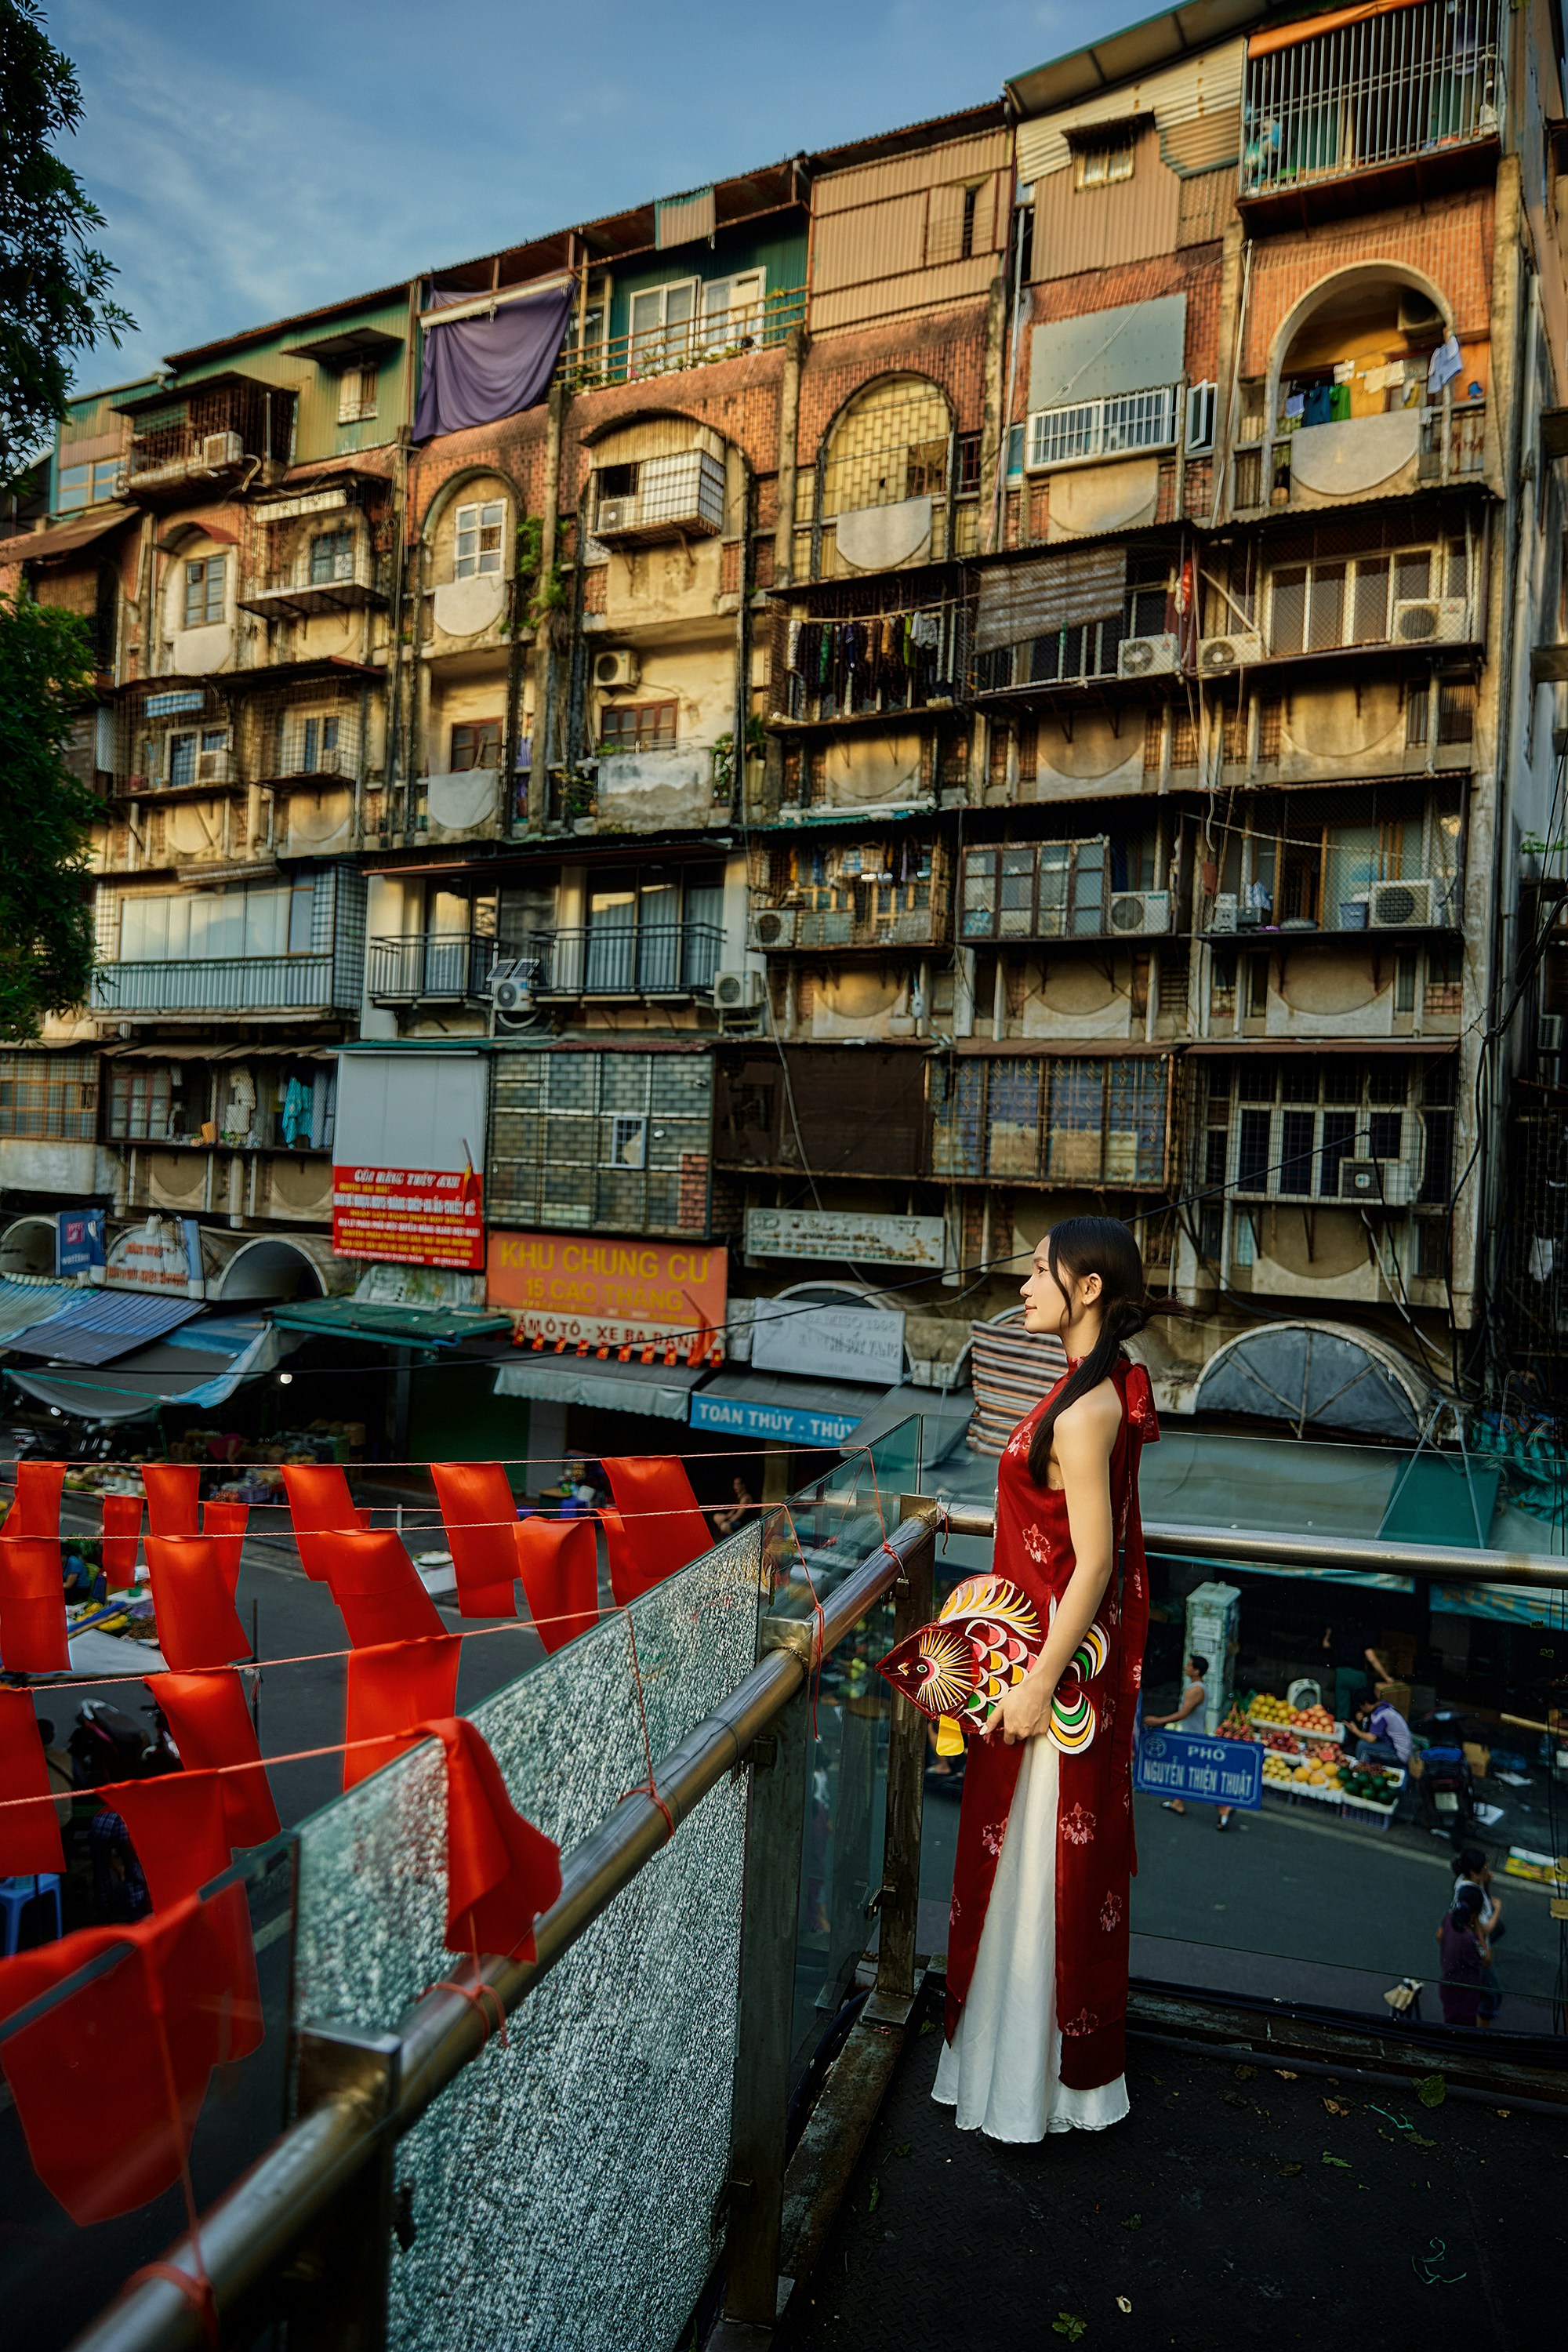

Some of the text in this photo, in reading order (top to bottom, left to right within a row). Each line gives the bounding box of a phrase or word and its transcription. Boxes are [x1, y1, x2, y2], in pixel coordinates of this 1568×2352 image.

[501, 1240, 555, 1270] KHU
[562, 1244, 659, 1279] CHUNG
[668, 1252, 711, 1283] CƯ
[526, 1277, 545, 1298] 15
[550, 1279, 597, 1305] CAO
[596, 1324, 618, 1341] XE
[624, 1327, 645, 1342] BA
[699, 1402, 743, 1425] TOÀN
[748, 1409, 793, 1432] THÚY
[1187, 1744, 1228, 1762] PHỐ
[1143, 1755, 1253, 1801] NGUYỄN THIỆN THUẬT
